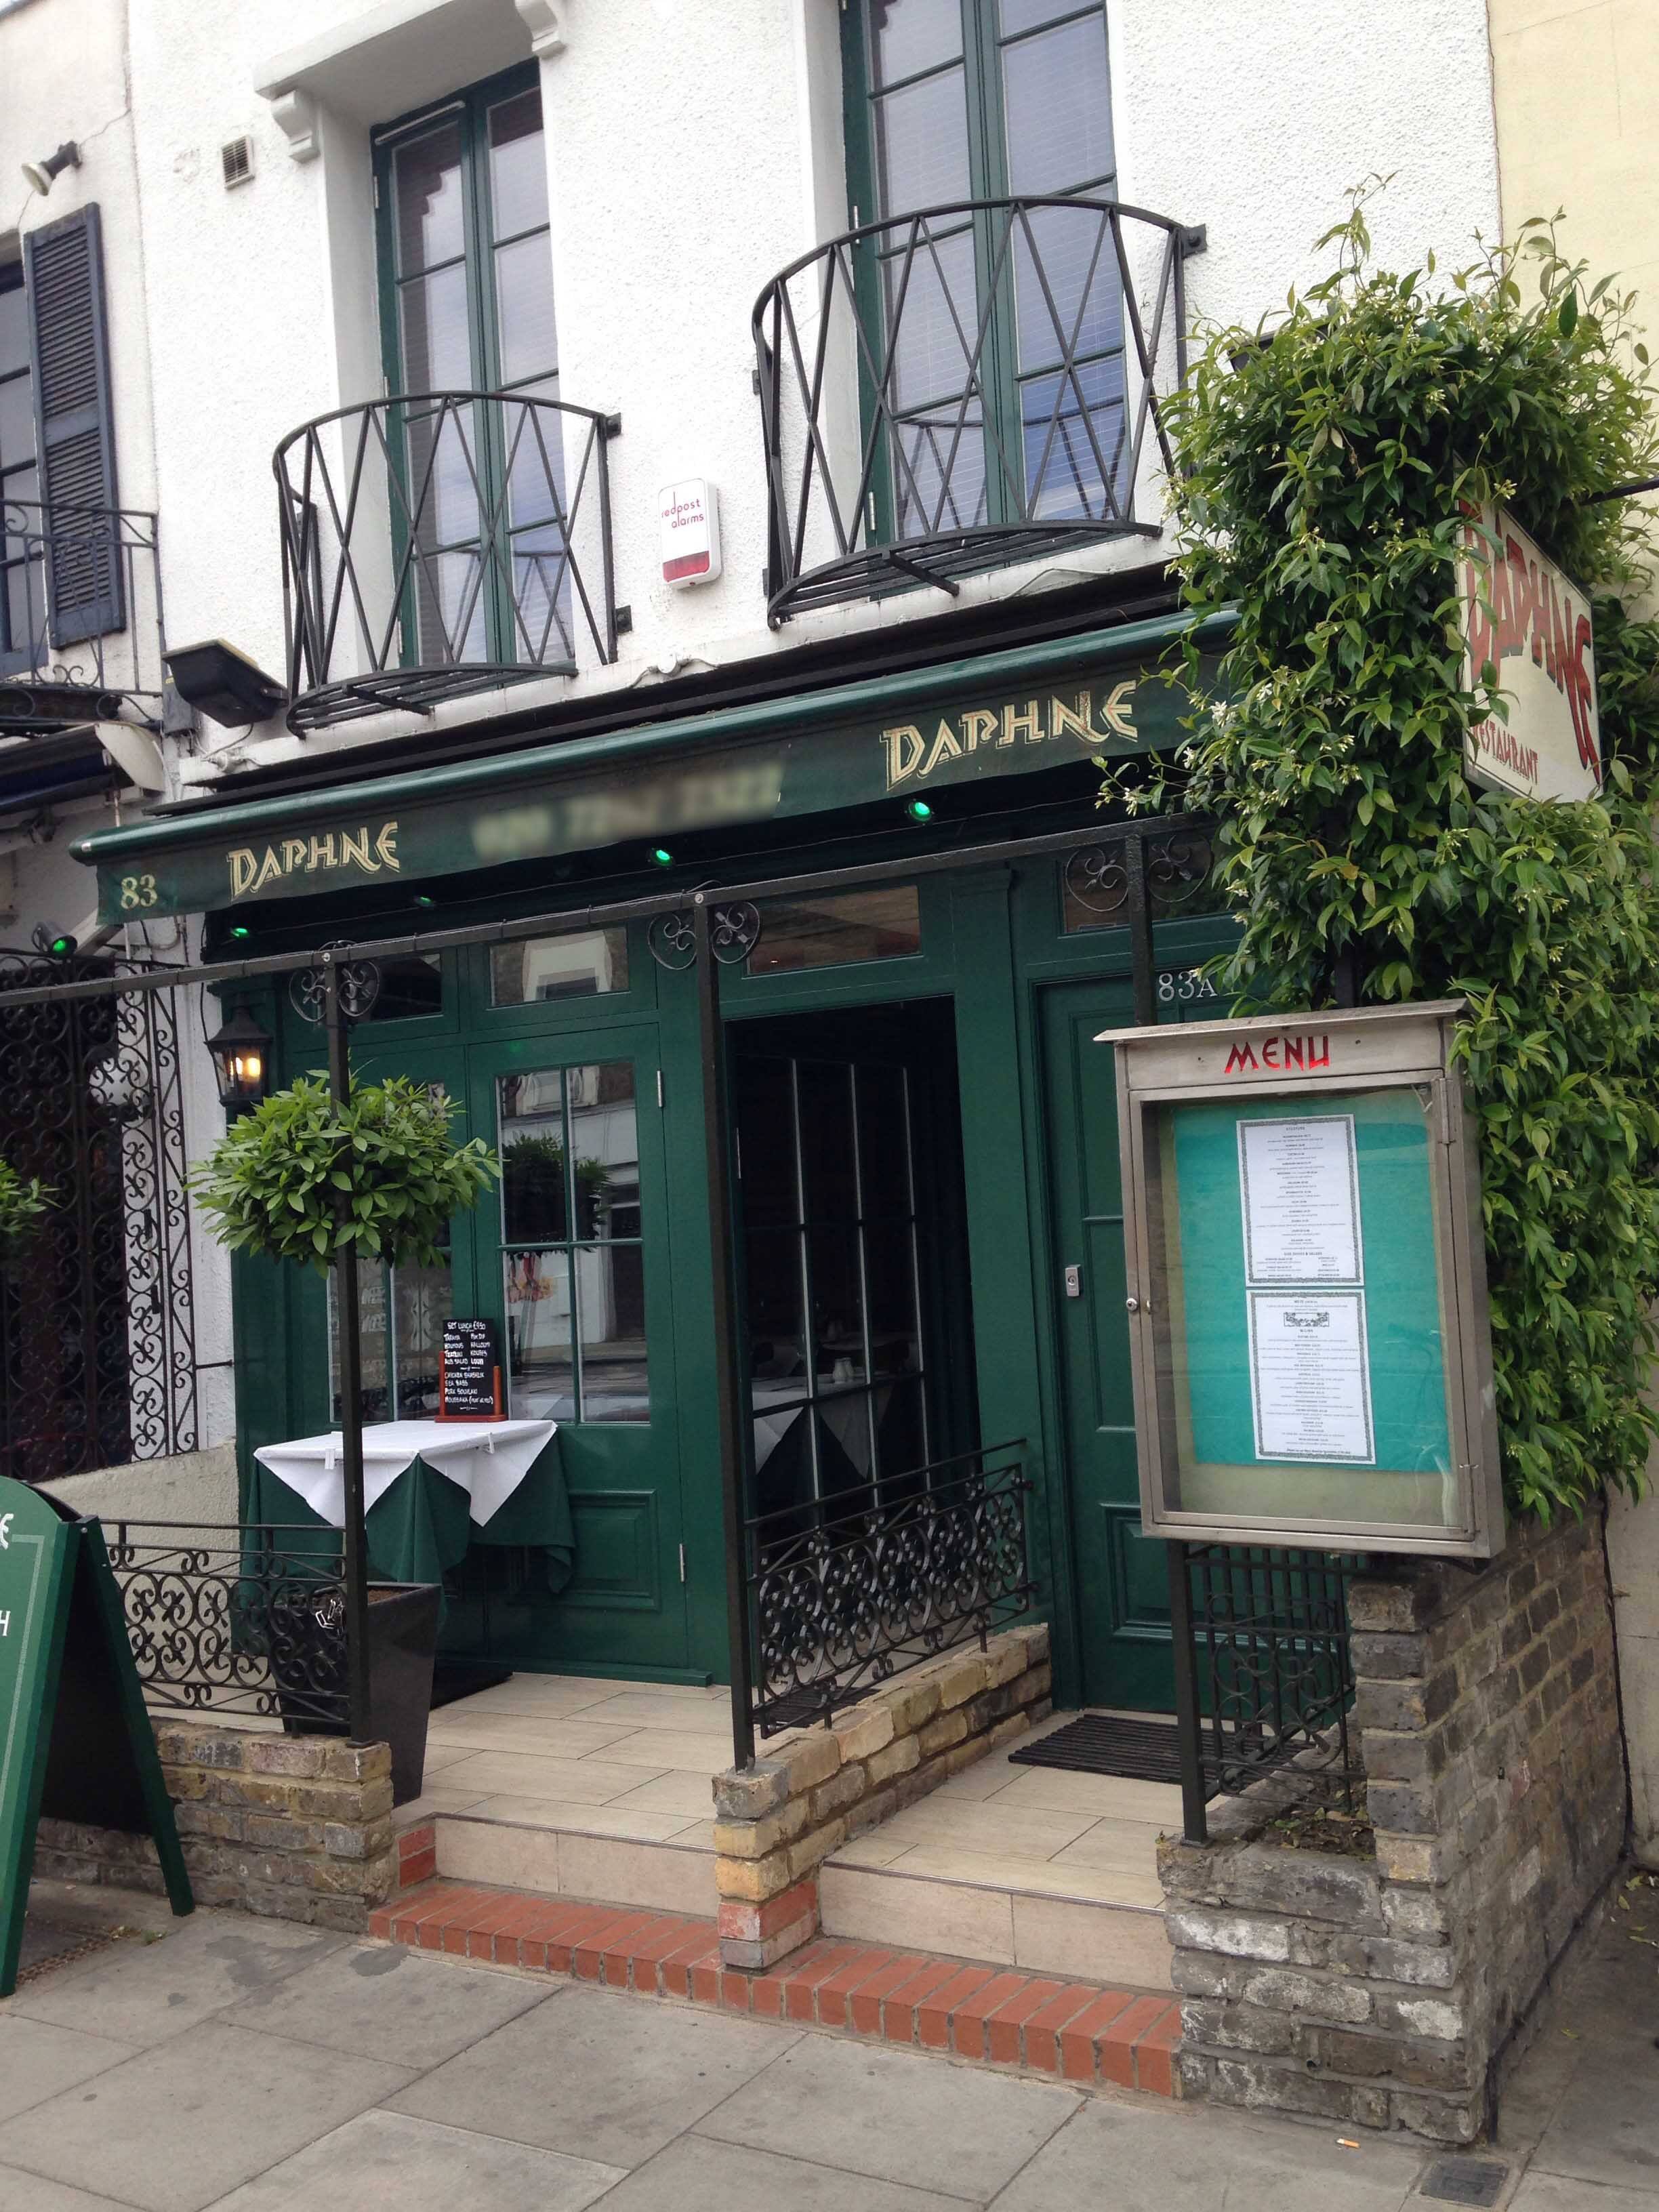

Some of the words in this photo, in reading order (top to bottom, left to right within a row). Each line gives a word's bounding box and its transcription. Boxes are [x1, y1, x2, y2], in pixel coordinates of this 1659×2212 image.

[661, 491, 701, 518] redpost
[672, 511, 704, 528] alarms
[880, 680, 1139, 792] DAPHNE
[226, 821, 400, 902] DAPHNE
[120, 874, 158, 910] 83
[1159, 971, 1218, 1002] 83A
[1224, 1035, 1330, 1073] MENU
